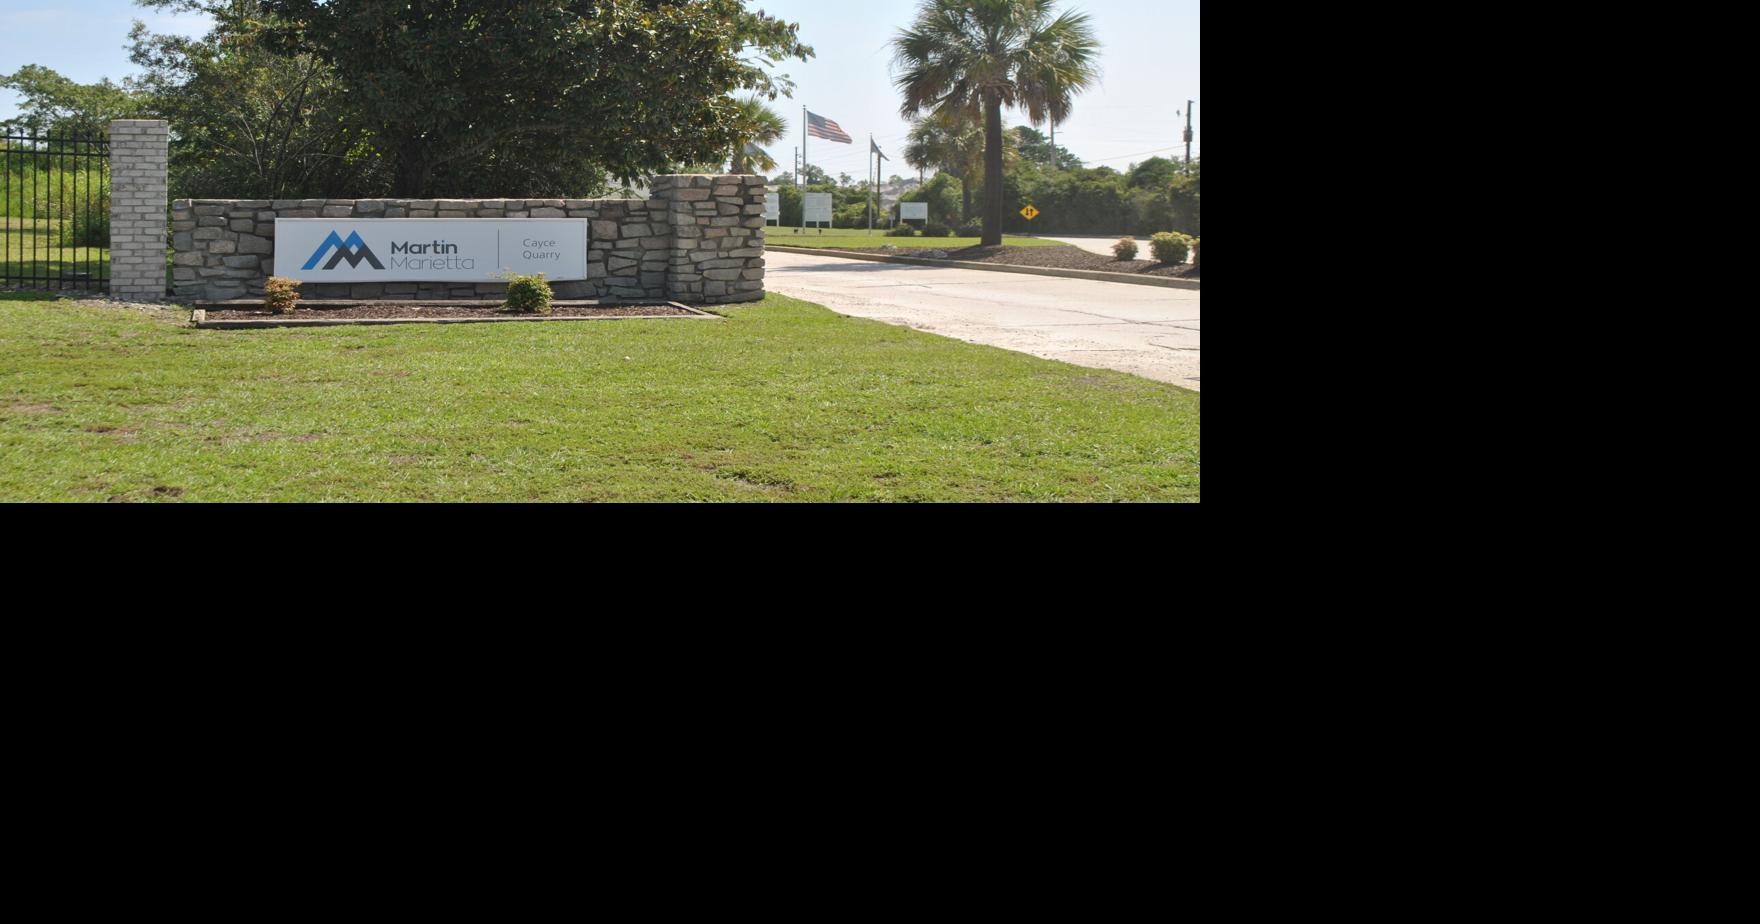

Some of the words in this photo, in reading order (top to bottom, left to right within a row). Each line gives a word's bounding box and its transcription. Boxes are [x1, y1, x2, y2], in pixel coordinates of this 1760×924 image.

[391, 240, 458, 254] Martin
[522, 238, 556, 249] Cayce
[522, 250, 561, 261] Quarry
[391, 256, 474, 270] Marietta
